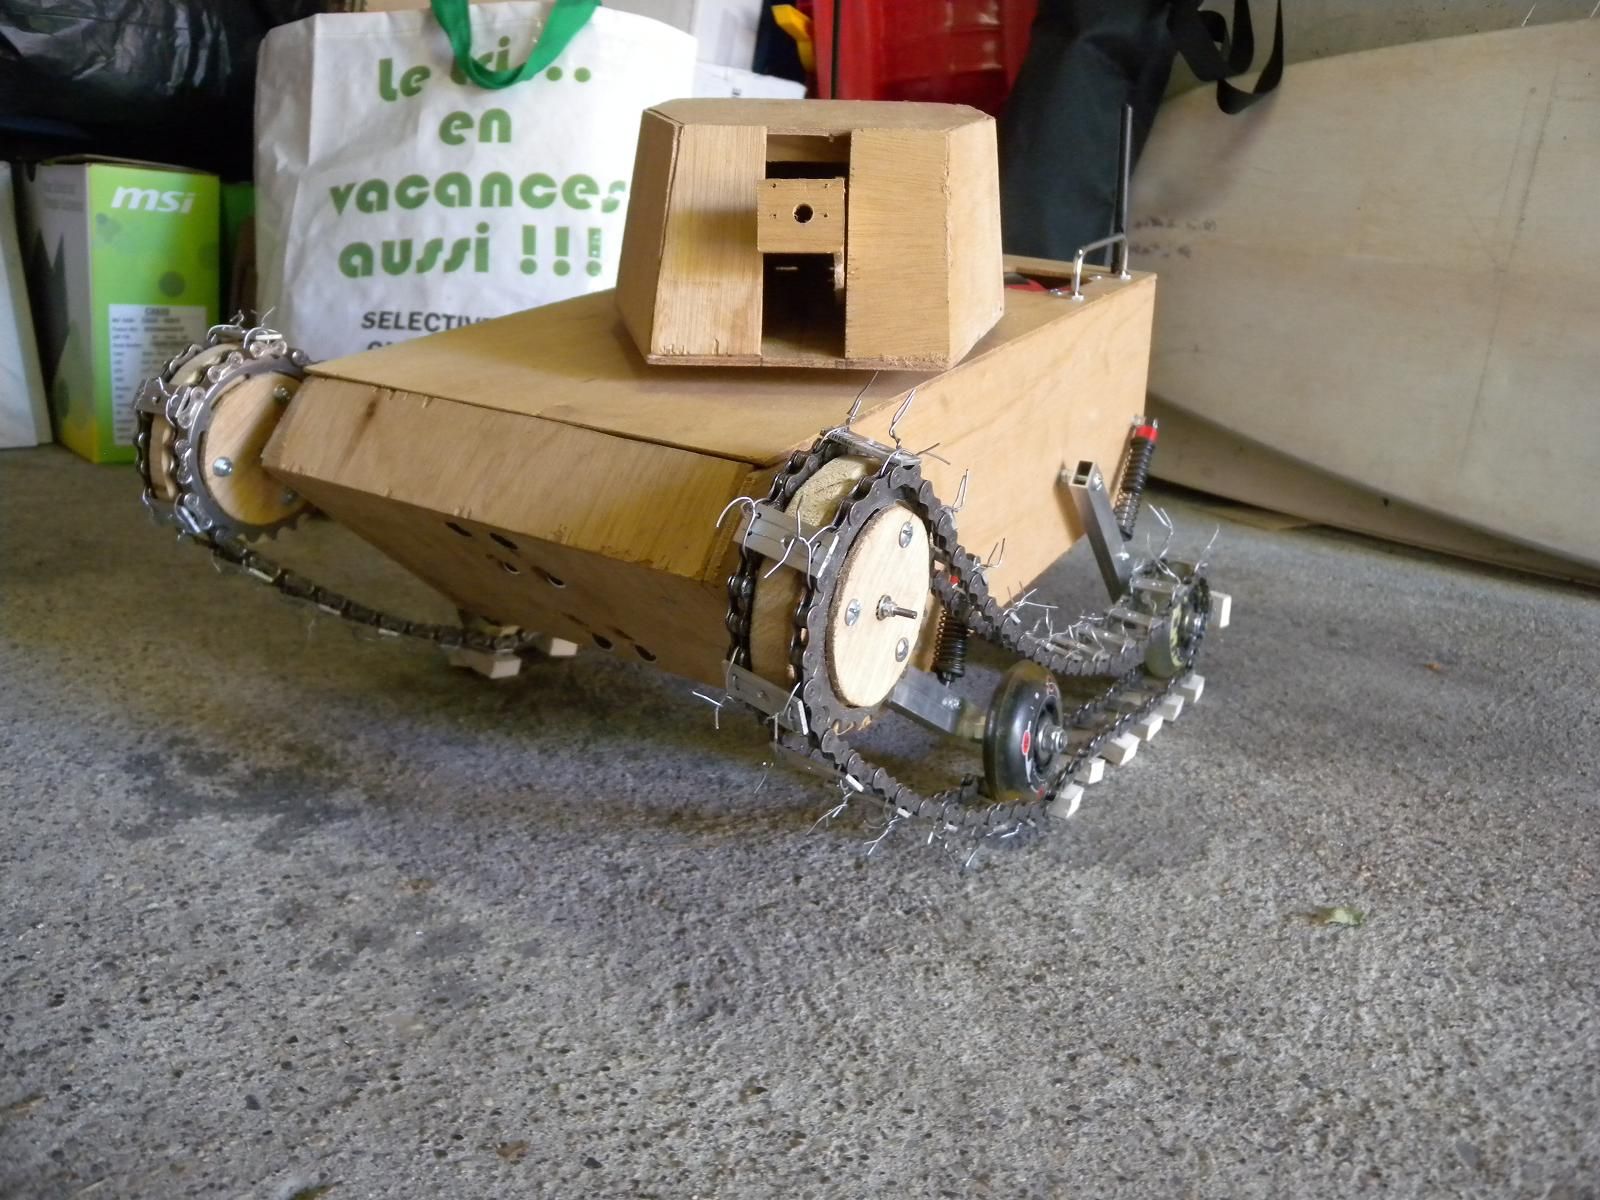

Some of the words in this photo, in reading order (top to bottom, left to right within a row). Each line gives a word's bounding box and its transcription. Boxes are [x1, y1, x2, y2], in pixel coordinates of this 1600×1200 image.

[438, 107, 512, 146] en
[111, 186, 195, 214] msi
[329, 171, 626, 216] vacances
[338, 221, 490, 278] aussi
